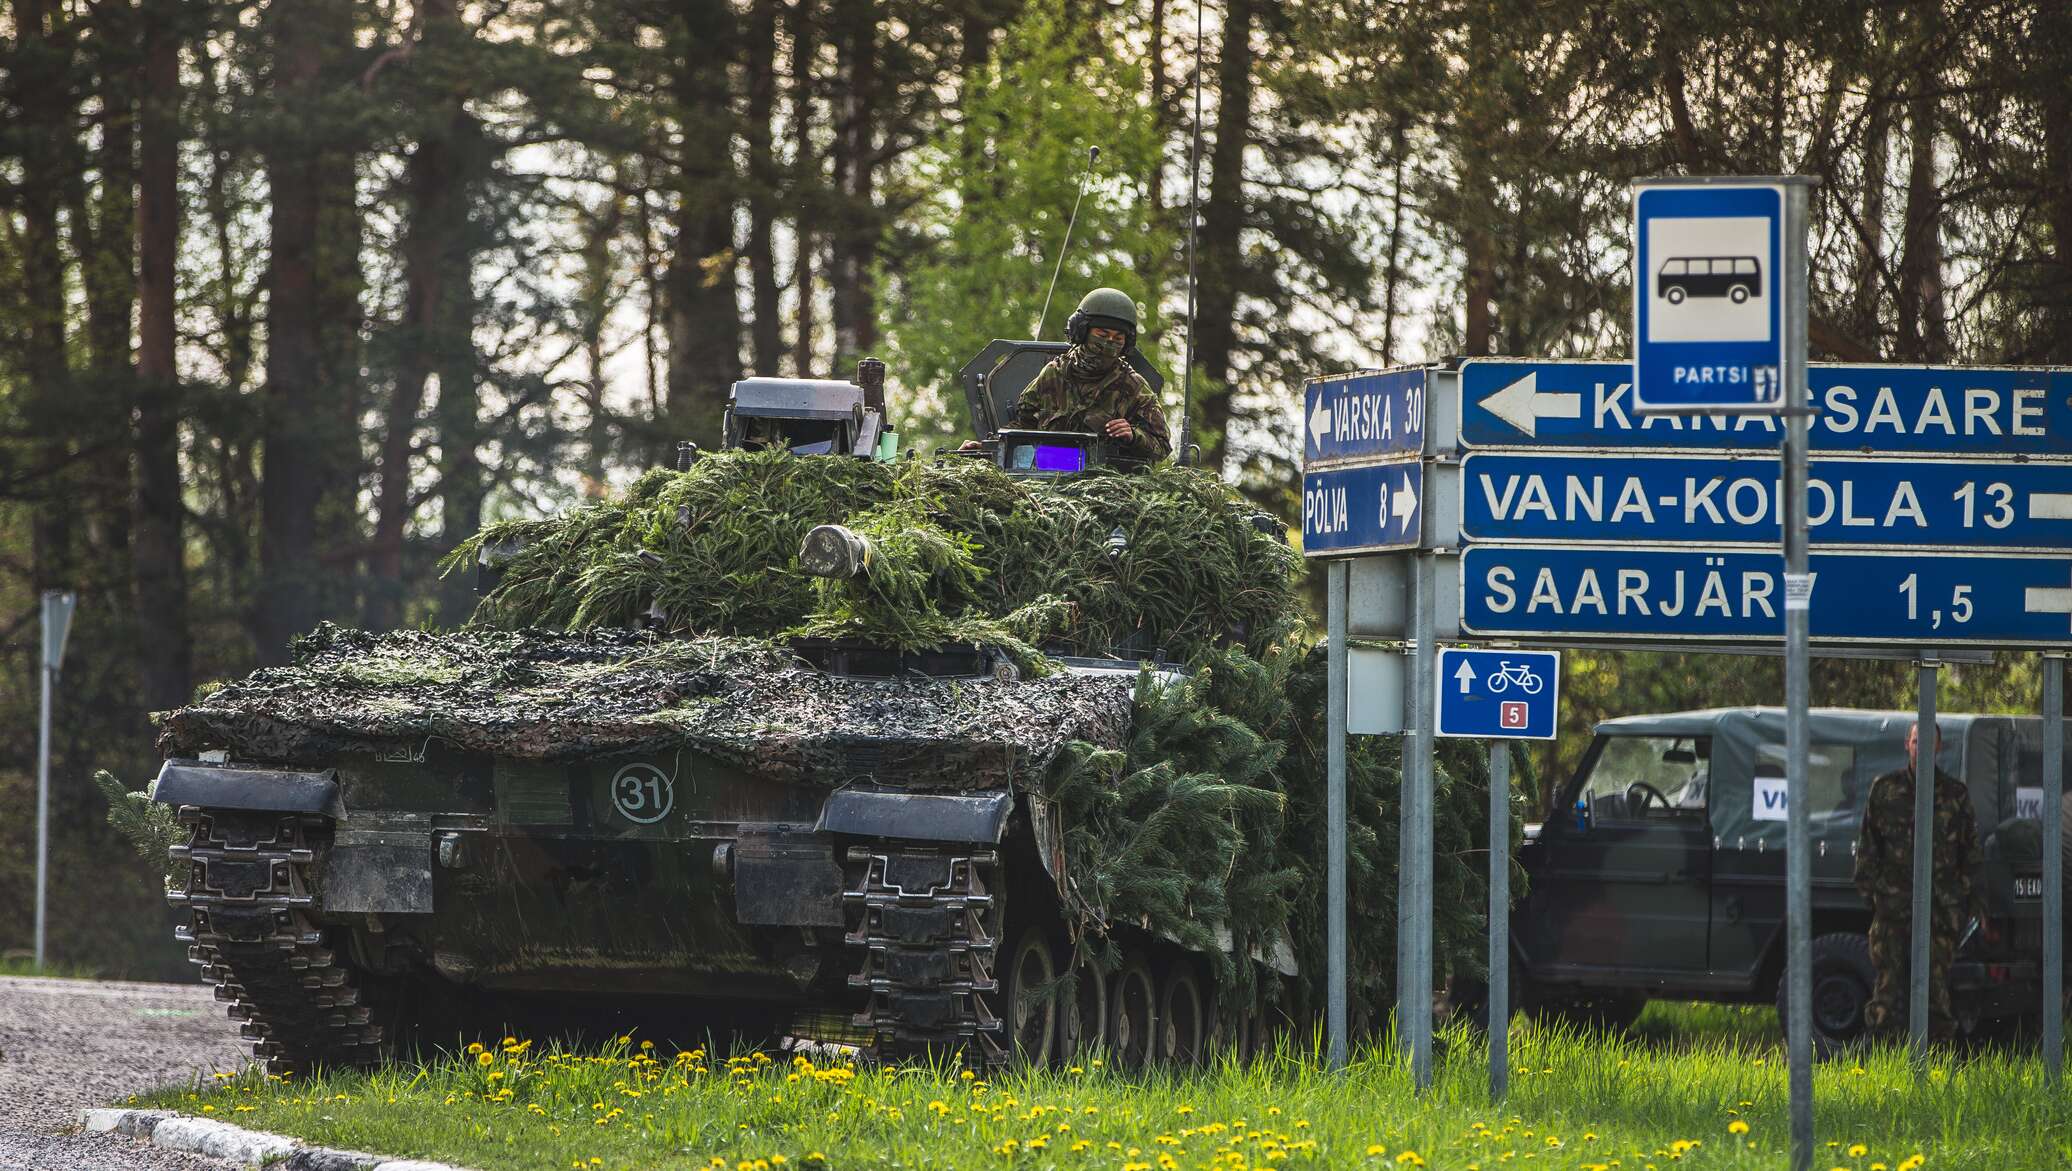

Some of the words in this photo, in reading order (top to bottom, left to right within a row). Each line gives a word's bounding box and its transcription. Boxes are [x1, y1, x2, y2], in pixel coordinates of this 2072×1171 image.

[1673, 366, 1748, 384] PARTSI
[1334, 385, 1392, 443] VÄRSKA
[1405, 387, 1421, 434] 30
[1594, 383, 2047, 436] KSAARE
[1306, 478, 1348, 535] PÕLVA
[1379, 472, 1387, 529] 8
[1953, 481, 2016, 529] 13
[1899, 573, 1973, 630] 1,5
[1509, 707, 1520, 723] 5
[620, 776, 661, 810] 31
